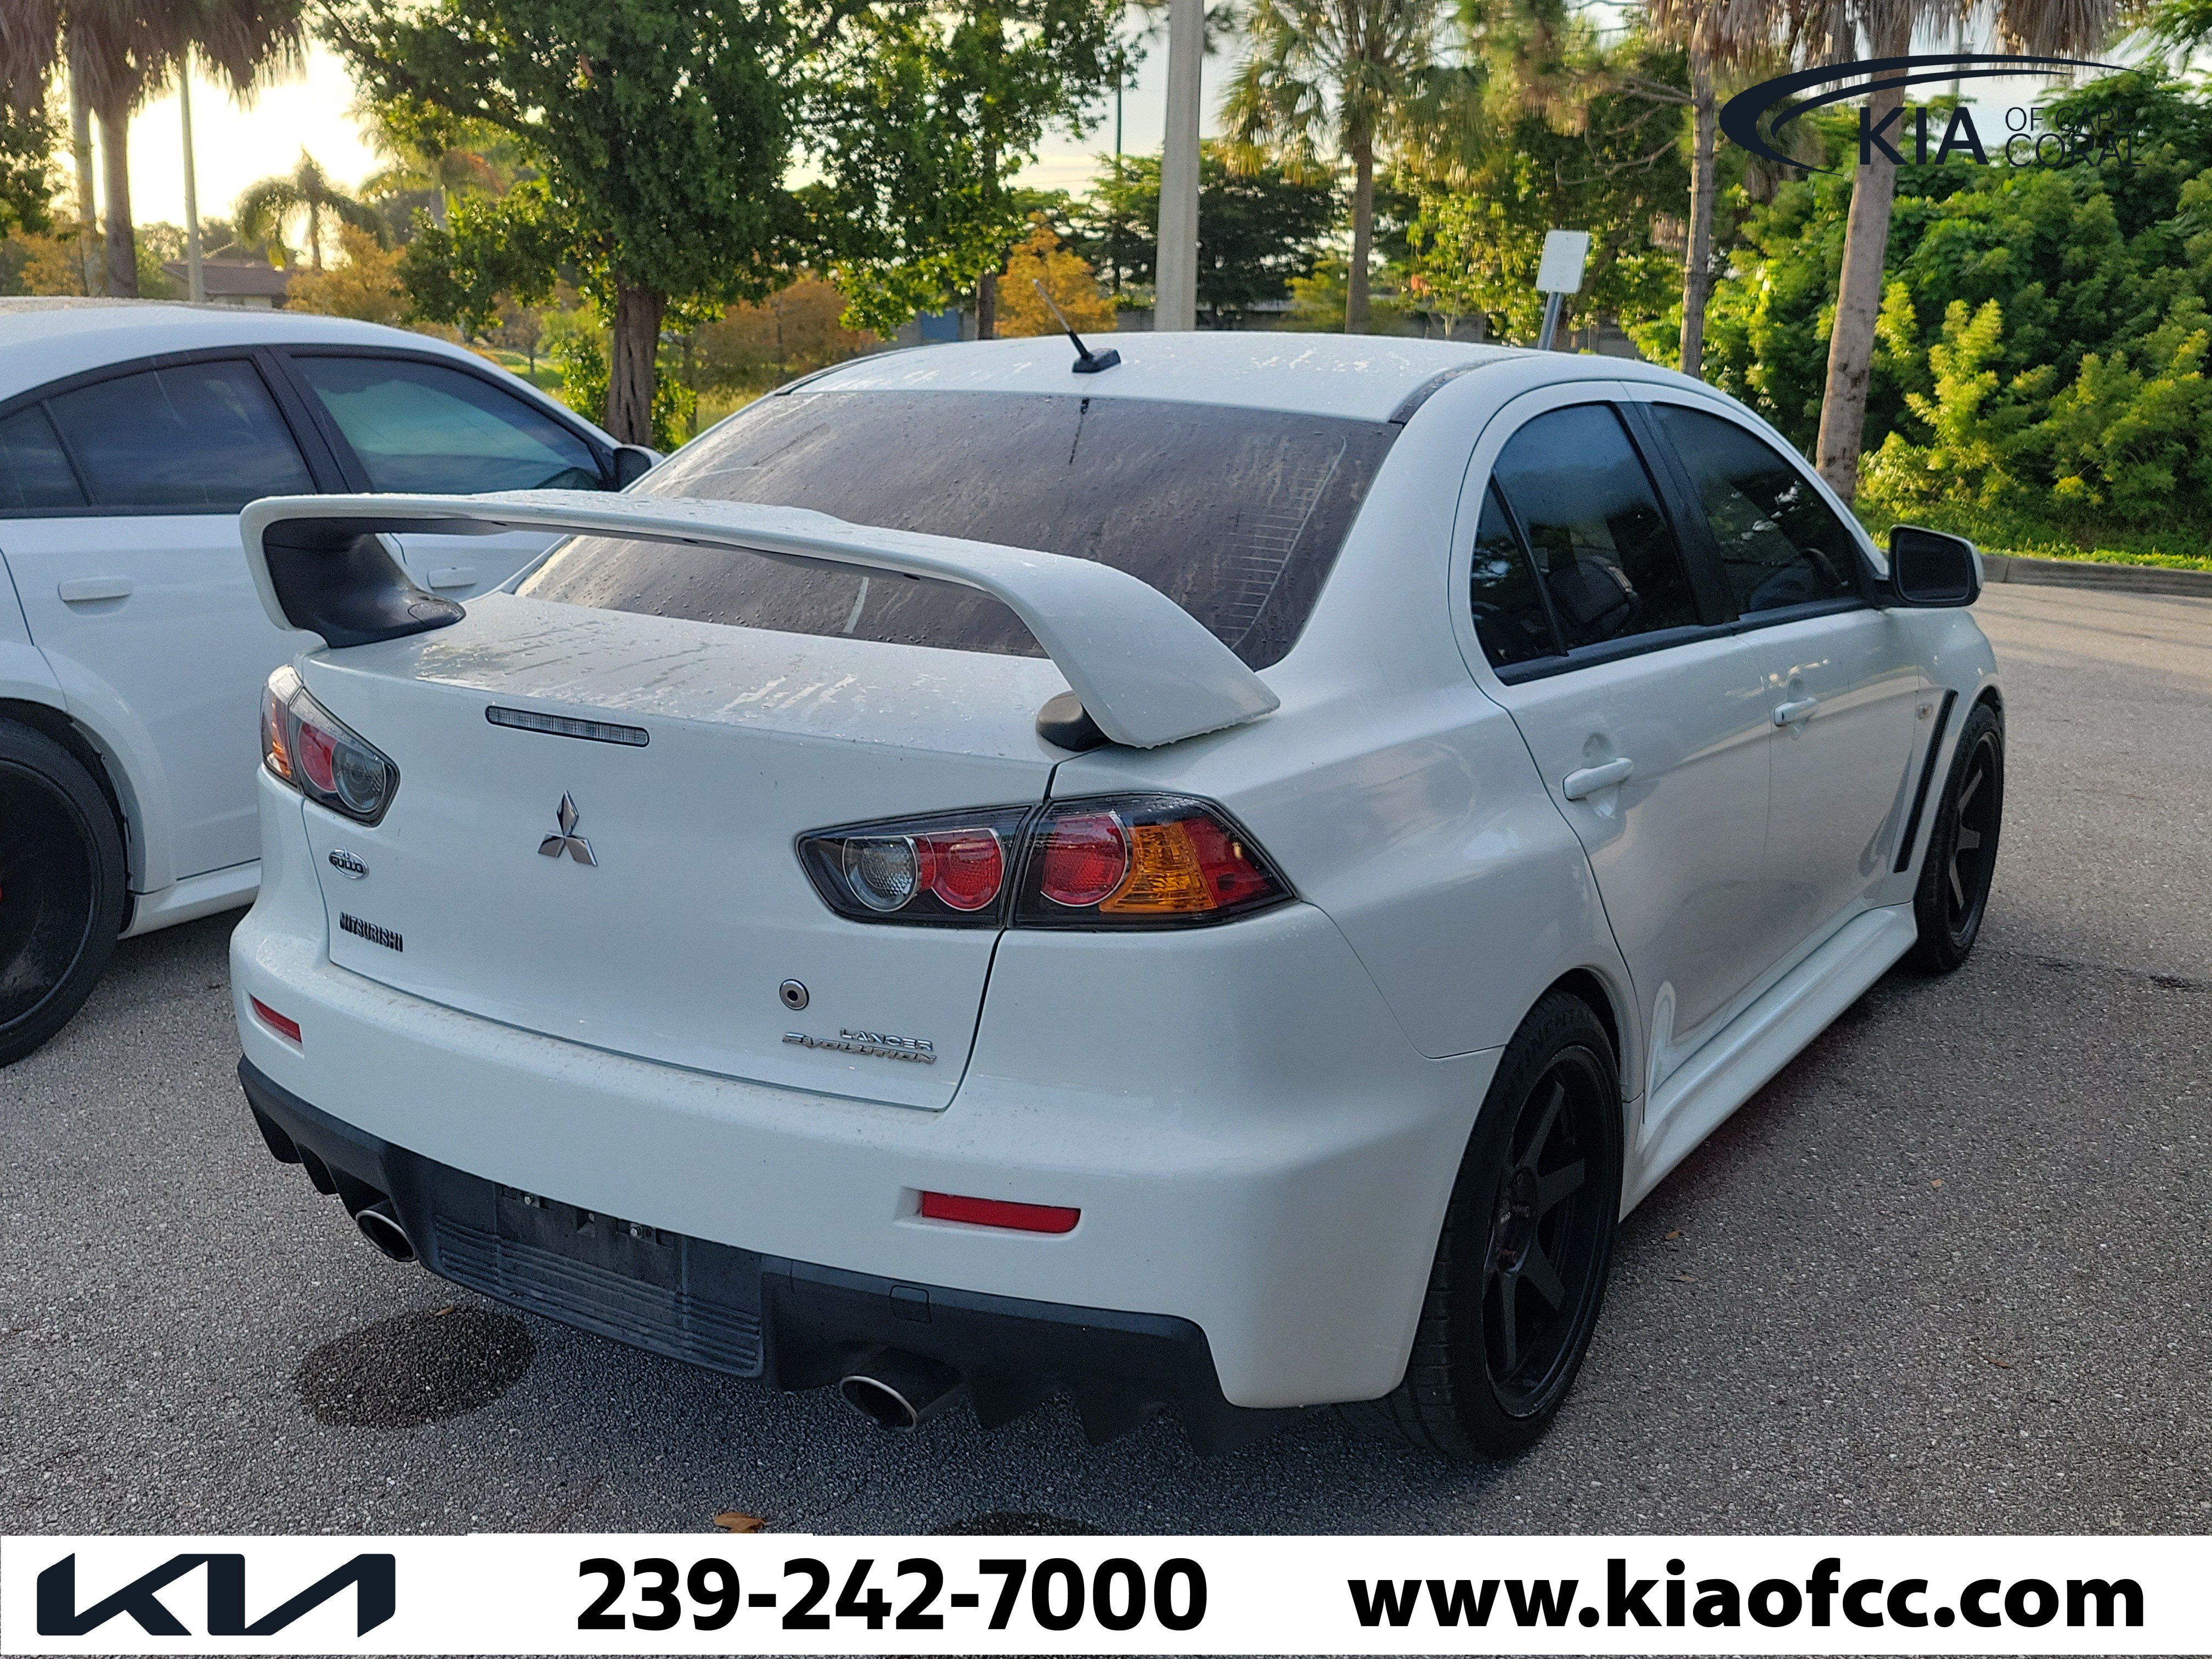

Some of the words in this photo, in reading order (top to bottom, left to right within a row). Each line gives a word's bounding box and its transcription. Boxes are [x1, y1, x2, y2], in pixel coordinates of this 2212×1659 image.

[340, 911, 403, 952] MITSUBISHI
[782, 1031, 938, 1065] EVOLUTION
[839, 1028, 934, 1051] LANCER
